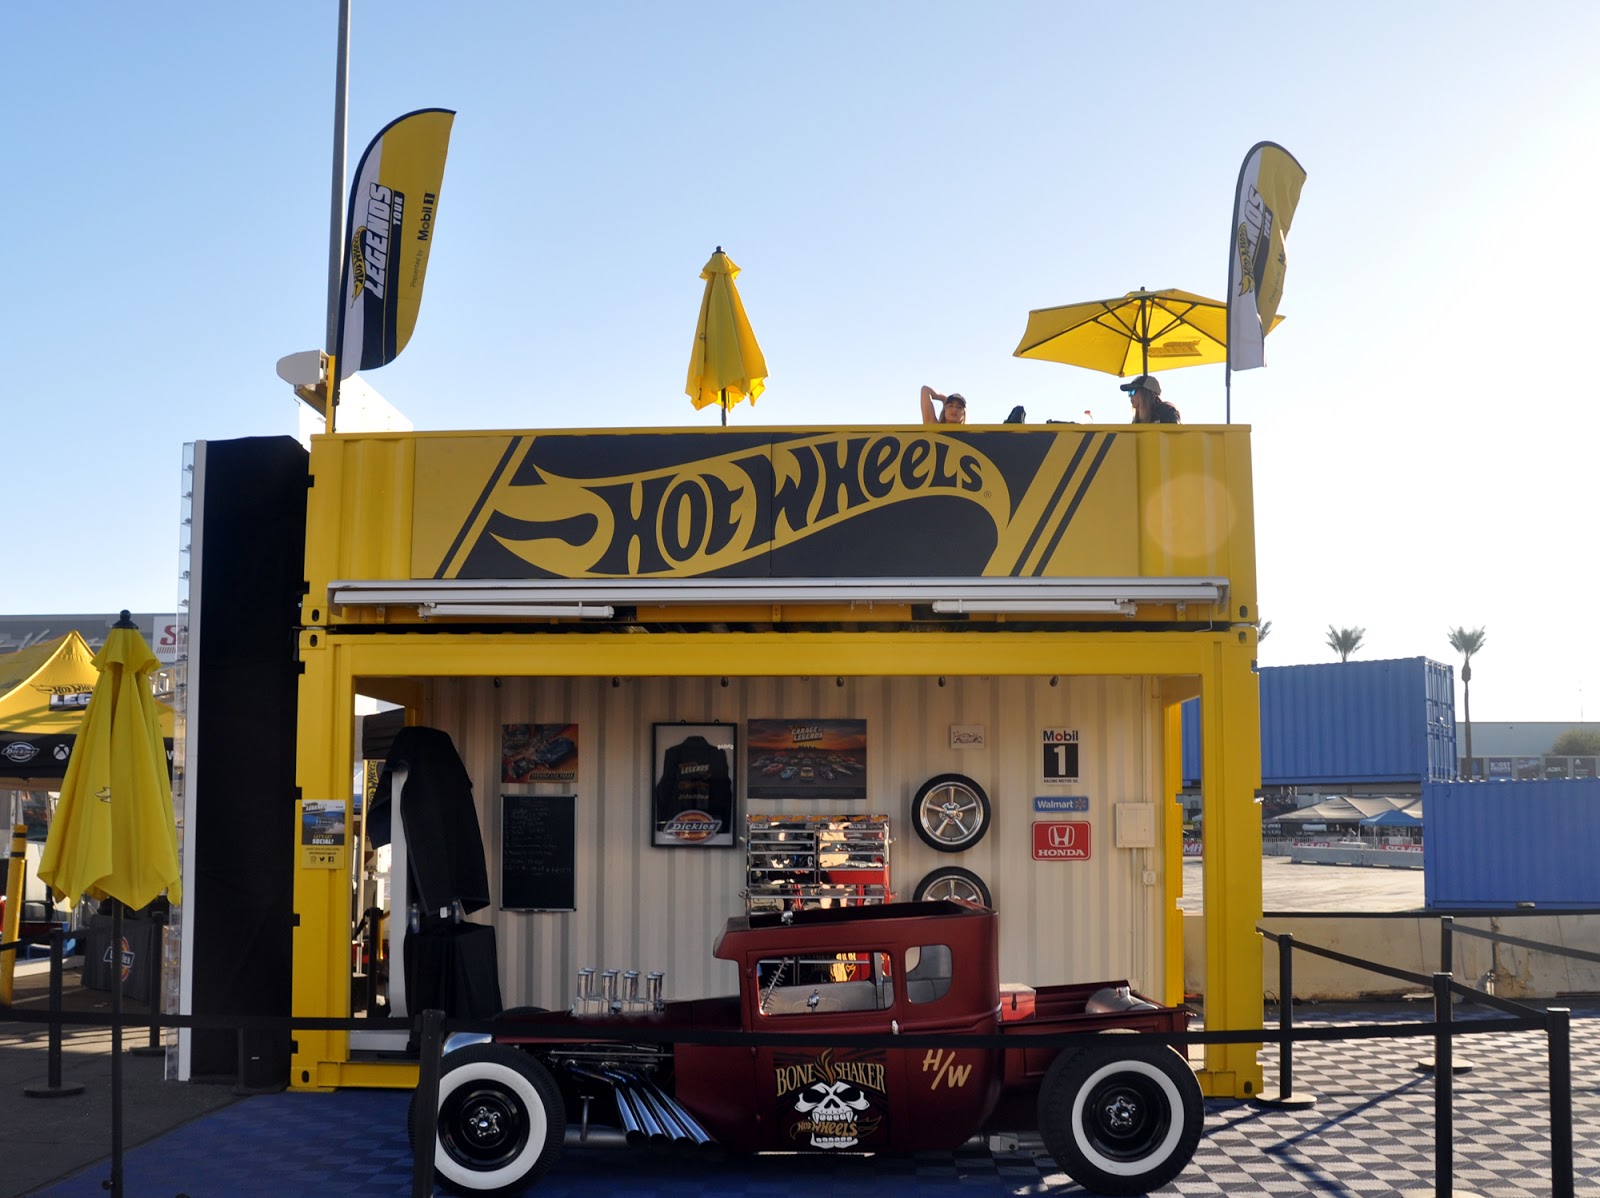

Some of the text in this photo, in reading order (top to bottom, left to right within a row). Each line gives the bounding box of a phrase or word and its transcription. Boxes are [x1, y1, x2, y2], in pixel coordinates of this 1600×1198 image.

[393, 196, 403, 225] TOUR
[417, 206, 433, 240] Mobil
[365, 182, 391, 299] LEGENDS
[410, 257, 421, 287] Presented
[580, 473, 745, 575] HOT
[53, 686, 72, 695] HOT
[791, 726, 819, 735] GARAGE
[793, 732, 824, 741] LEGENDS
[1043, 730, 1079, 741] Mobil
[1054, 745, 1066, 776] 1
[1037, 799, 1074, 809] Walmart
[671, 822, 716, 830] Dickies
[1038, 849, 1085, 857] HONDA
[775, 1062, 887, 1097] BONE SHAKER
[923, 1049, 972, 1090] H/W
[798, 1121, 813, 1131] HOT
